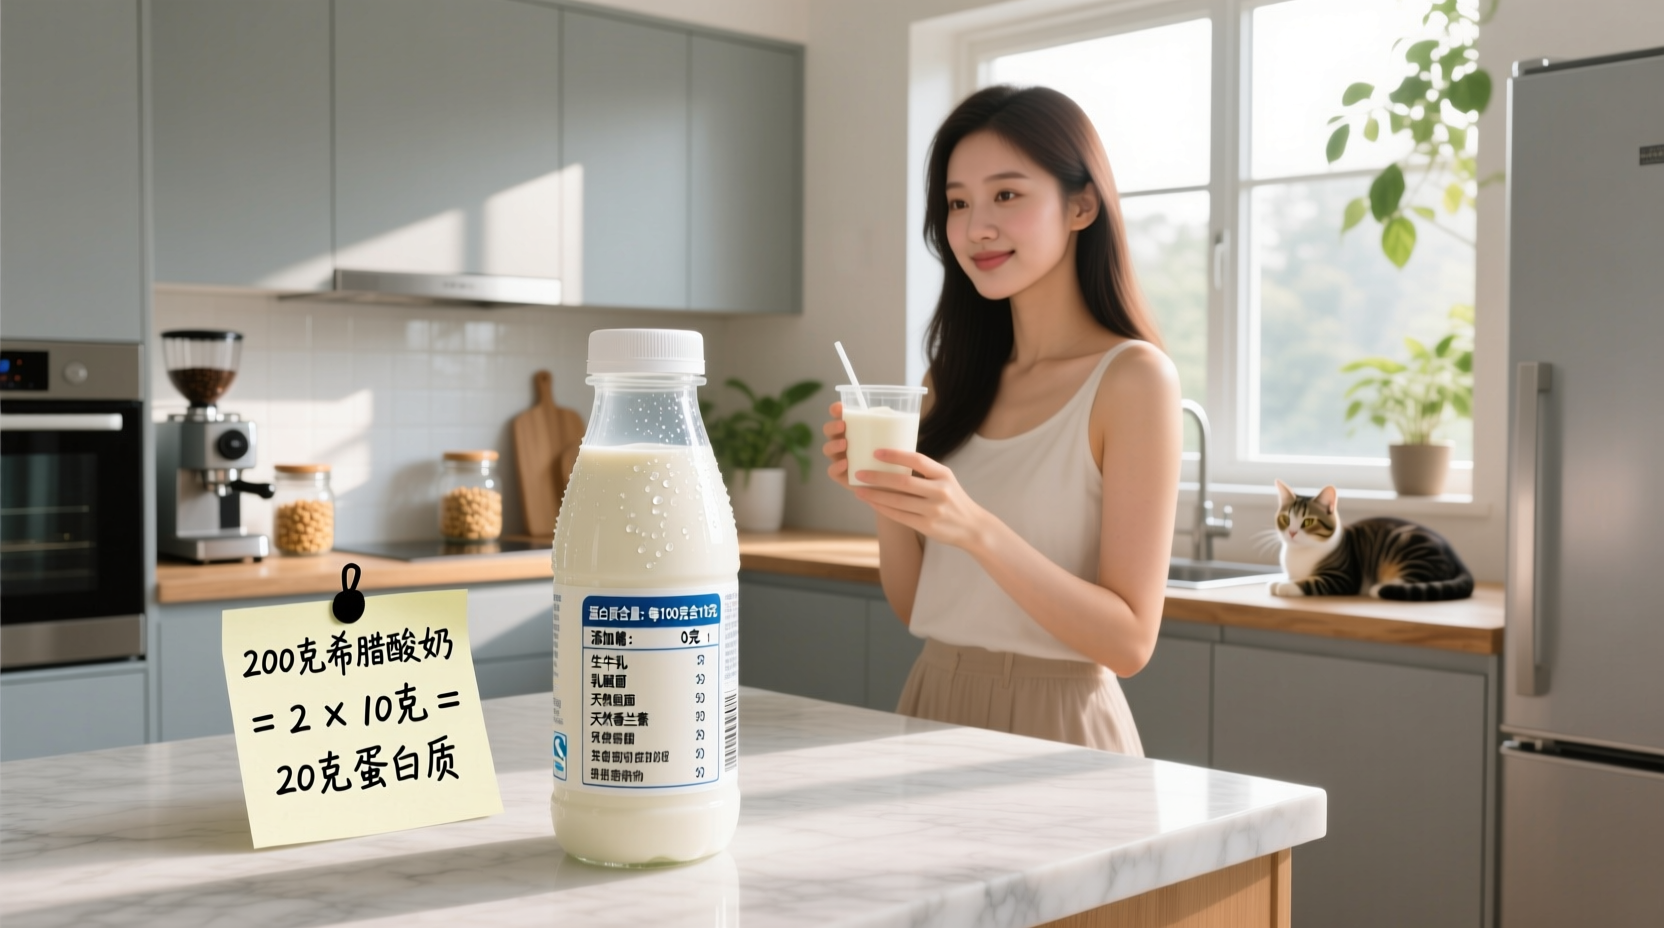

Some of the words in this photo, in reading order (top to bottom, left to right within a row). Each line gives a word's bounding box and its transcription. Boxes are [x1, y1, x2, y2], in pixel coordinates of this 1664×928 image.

[243, 626, 453, 678] 200克希腊酸奶
[591, 654, 628, 672] 生牛乳
[252, 713, 275, 733] =
[290, 704, 311, 734] 2
[364, 682, 429, 726] 10克
[437, 691, 460, 709] =
[276, 735, 459, 795] 20克蛋白质
